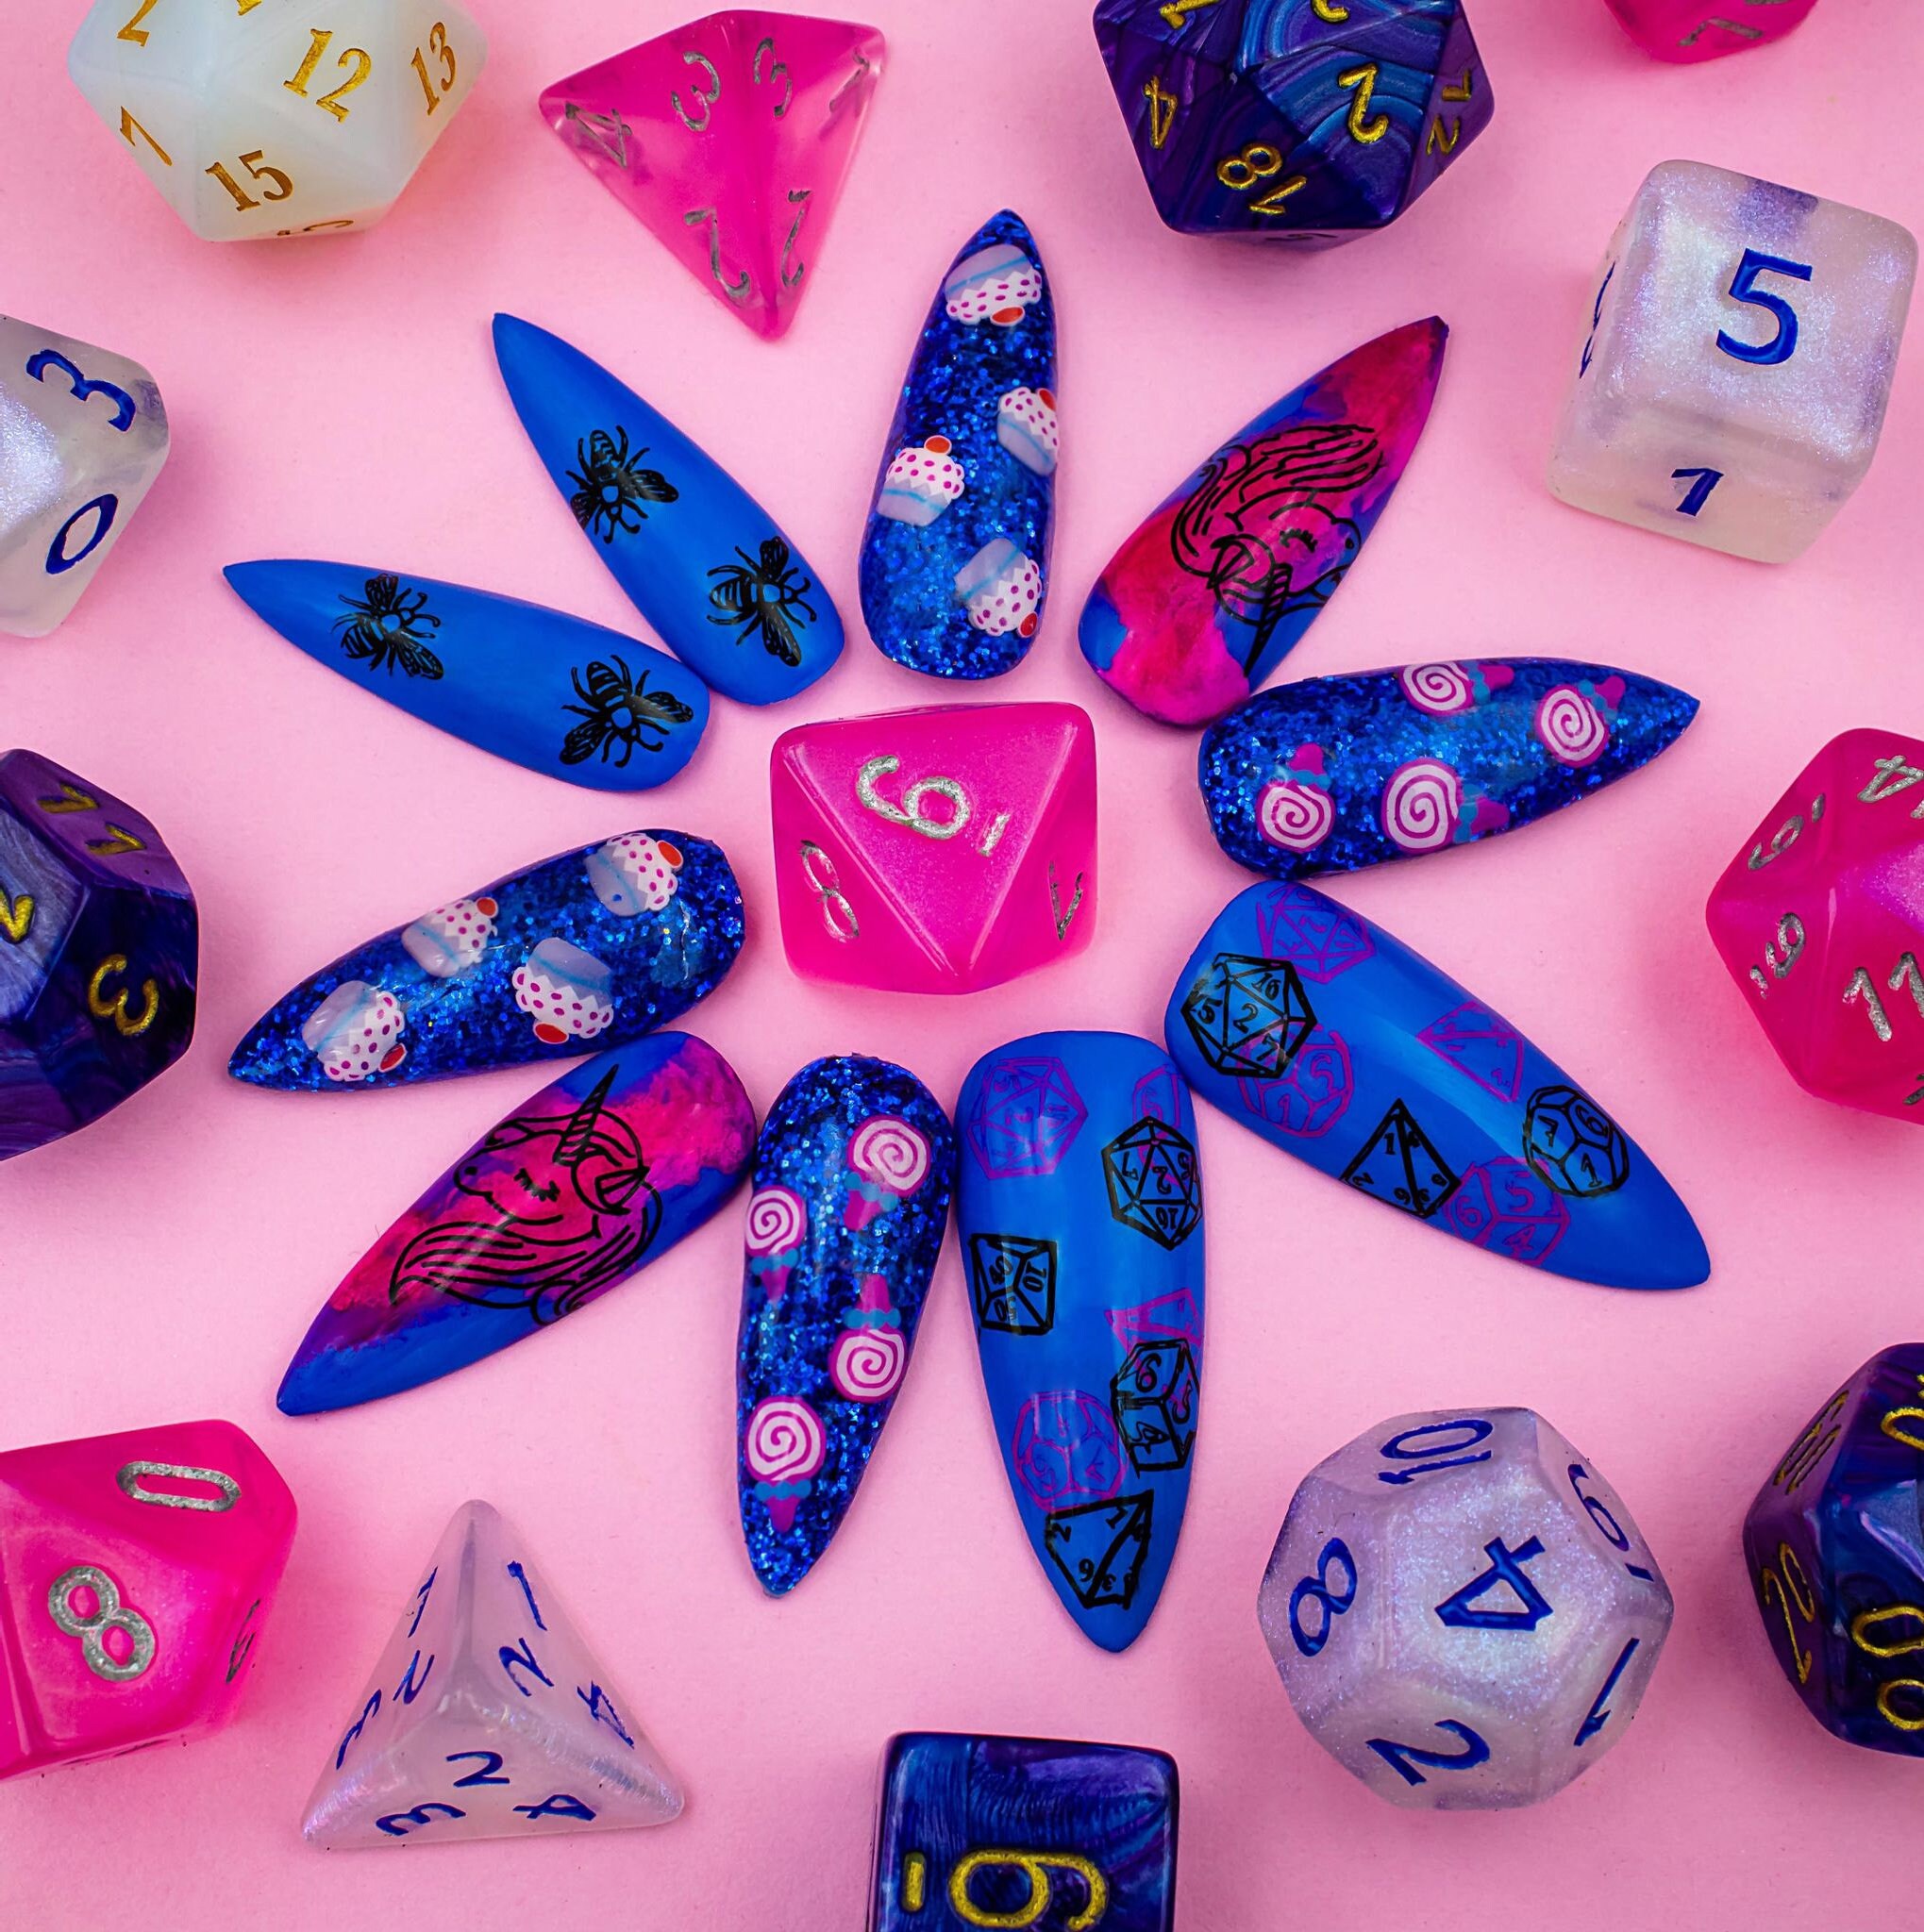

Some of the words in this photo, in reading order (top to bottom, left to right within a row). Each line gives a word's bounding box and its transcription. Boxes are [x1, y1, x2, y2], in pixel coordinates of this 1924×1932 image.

[283, 28, 372, 123] 12
[411, 22, 457, 116] 13
[670, 51, 721, 132] 3
[752, 37, 793, 117] 3
[1338, 62, 1389, 144] 2
[120, 106, 172, 166] 7
[564, 102, 633, 170] 4
[1143, 75, 1179, 150] 4
[205, 149, 293, 212] 15
[1216, 142, 1308, 216] 18
[683, 205, 751, 298] 2
[1715, 247, 1813, 366] 5
[25, 349, 137, 432] 3
[45, 493, 119, 575] 0
[798, 839, 861, 943] 8
[87, 954, 159, 1037] 3
[1232, 1003, 1259, 1034] 2
[1383, 1132, 1396, 1156] 1
[1581, 1152, 1603, 1188] 1
[1455, 1194, 1482, 1228] 6
[1135, 1353, 1163, 1390] 6
[115, 1460, 243, 1512] 0
[1378, 1419, 1494, 1485] 10
[408, 1566, 438, 1639] 1
[507, 1560, 548, 1632] 1
[1288, 1537, 1358, 1657] 8
[1434, 1535, 1554, 1632] 4
[47, 1564, 156, 1683] 8
[392, 1650, 435, 1705] 2
[498, 1638, 555, 1697] 2
[445, 1751, 510, 1788] 2
[1364, 1719, 1491, 1787] 2
[376, 1803, 467, 1837] 3
[512, 1794, 597, 1823] 4
